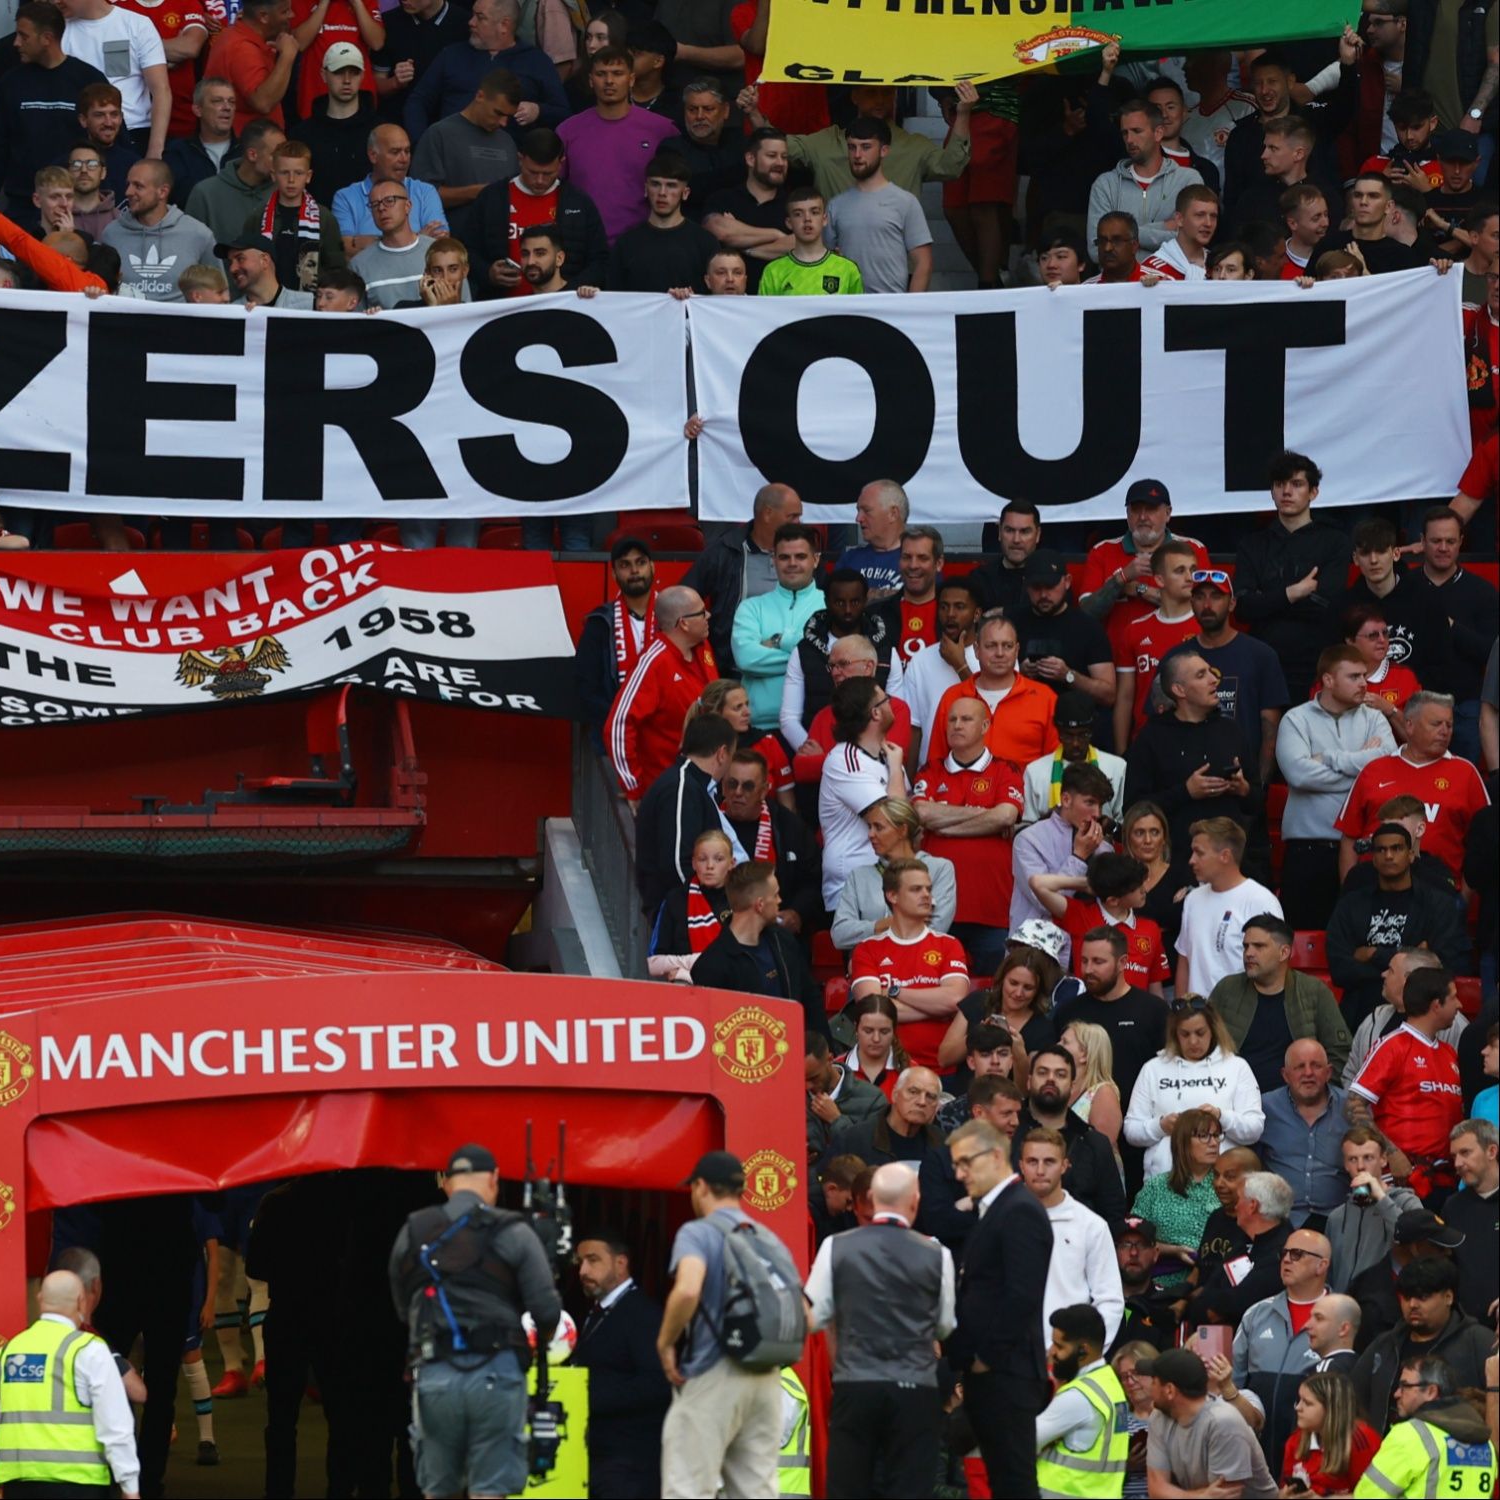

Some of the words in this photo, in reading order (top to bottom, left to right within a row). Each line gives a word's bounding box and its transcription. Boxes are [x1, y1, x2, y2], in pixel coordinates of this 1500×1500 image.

[738, 300, 1347, 505] OUT
[48, 622, 205, 648] CLUB
[227, 561, 380, 637] BACK
[108, 566, 277, 624] WANT
[322, 606, 476, 651] 1958
[383, 656, 482, 687] ARE
[438, 683, 543, 711] FOR
[720, 1011, 781, 1037] MANCHESTER
[40, 1022, 460, 1081] MANCHESTER
[476, 1015, 707, 1068] UNITED
[730, 1063, 773, 1078] UNITED
[19, 1364, 45, 1378] CSG
[1448, 1470, 1463, 1492] 5
[1478, 1472, 1491, 1494] 8
